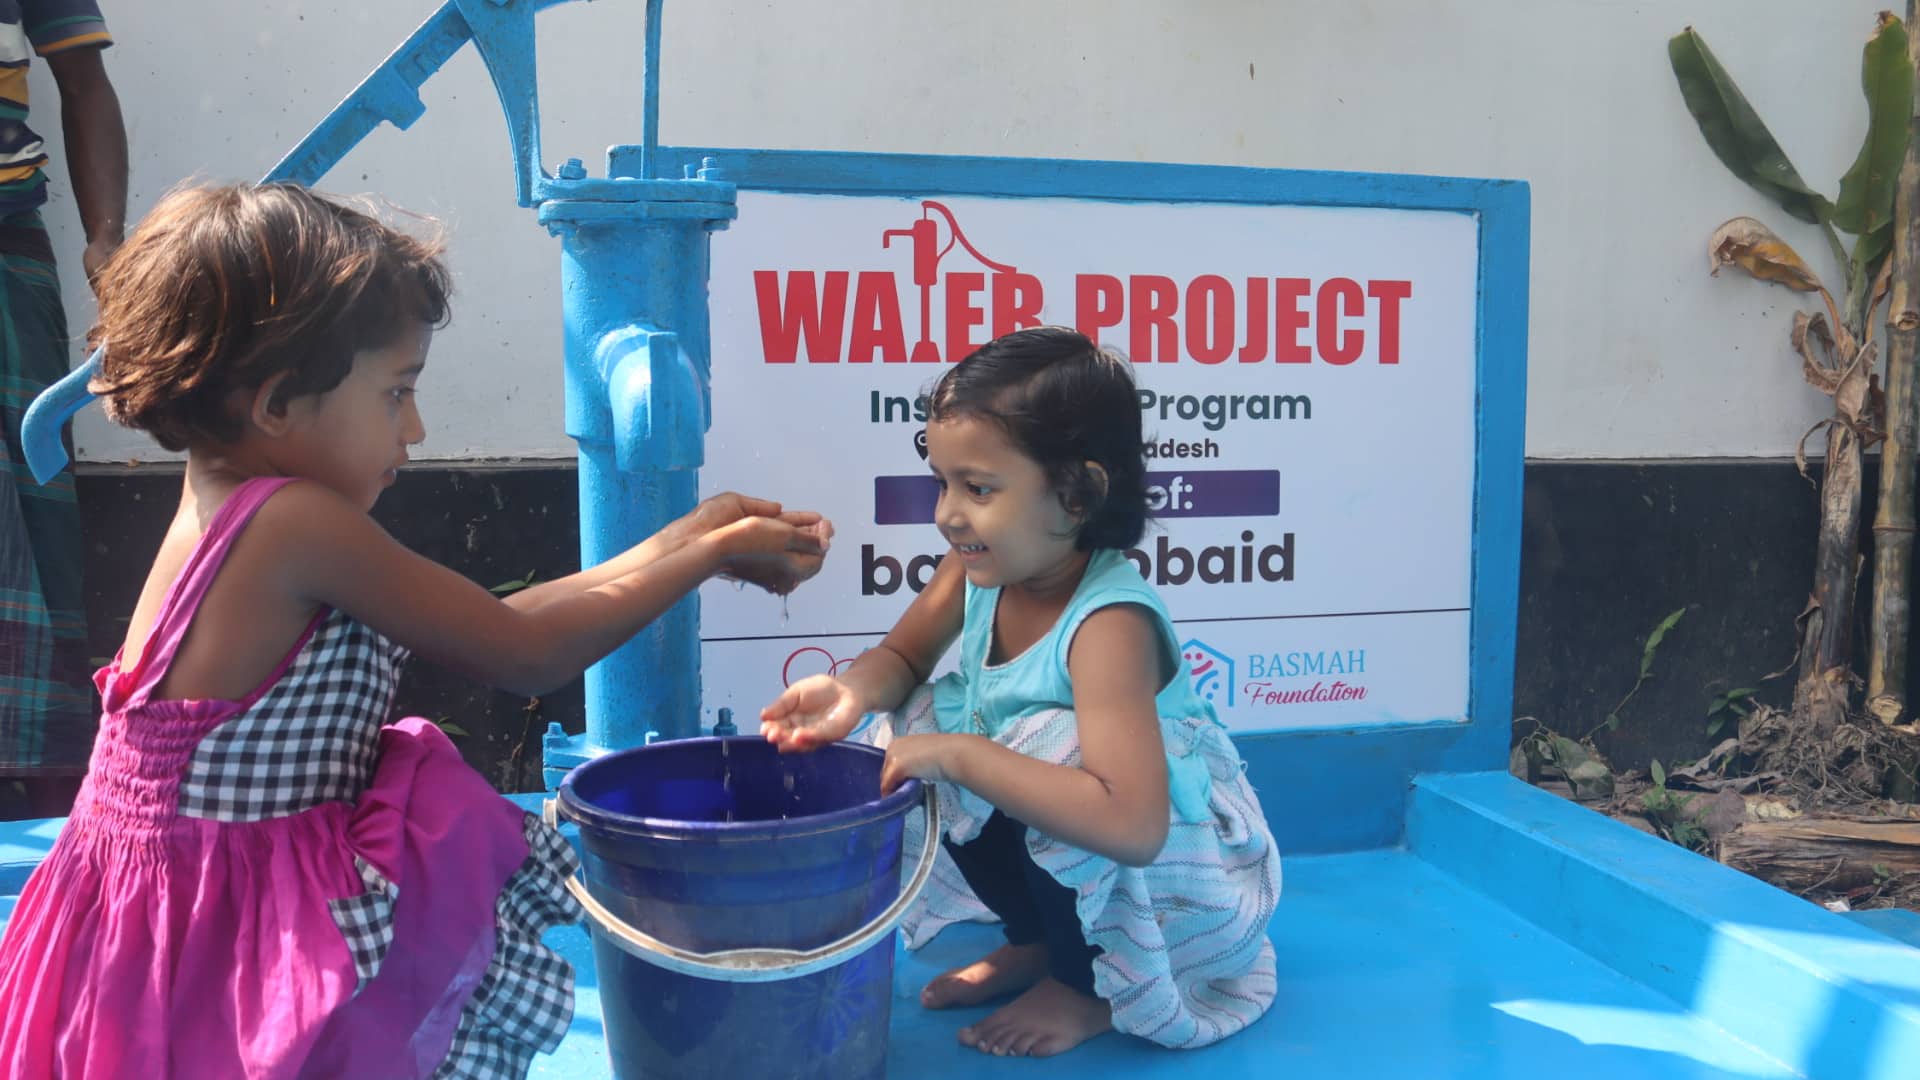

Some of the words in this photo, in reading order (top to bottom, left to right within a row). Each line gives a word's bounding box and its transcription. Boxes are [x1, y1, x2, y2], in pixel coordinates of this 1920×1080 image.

[1075, 274, 1412, 366] PROJECT
[1134, 389, 1312, 431] Program
[1142, 438, 1219, 458] adesh
[1146, 476, 1193, 510] of:
[1247, 649, 1366, 679] BASMAH
[1244, 680, 1368, 706] Foundation
